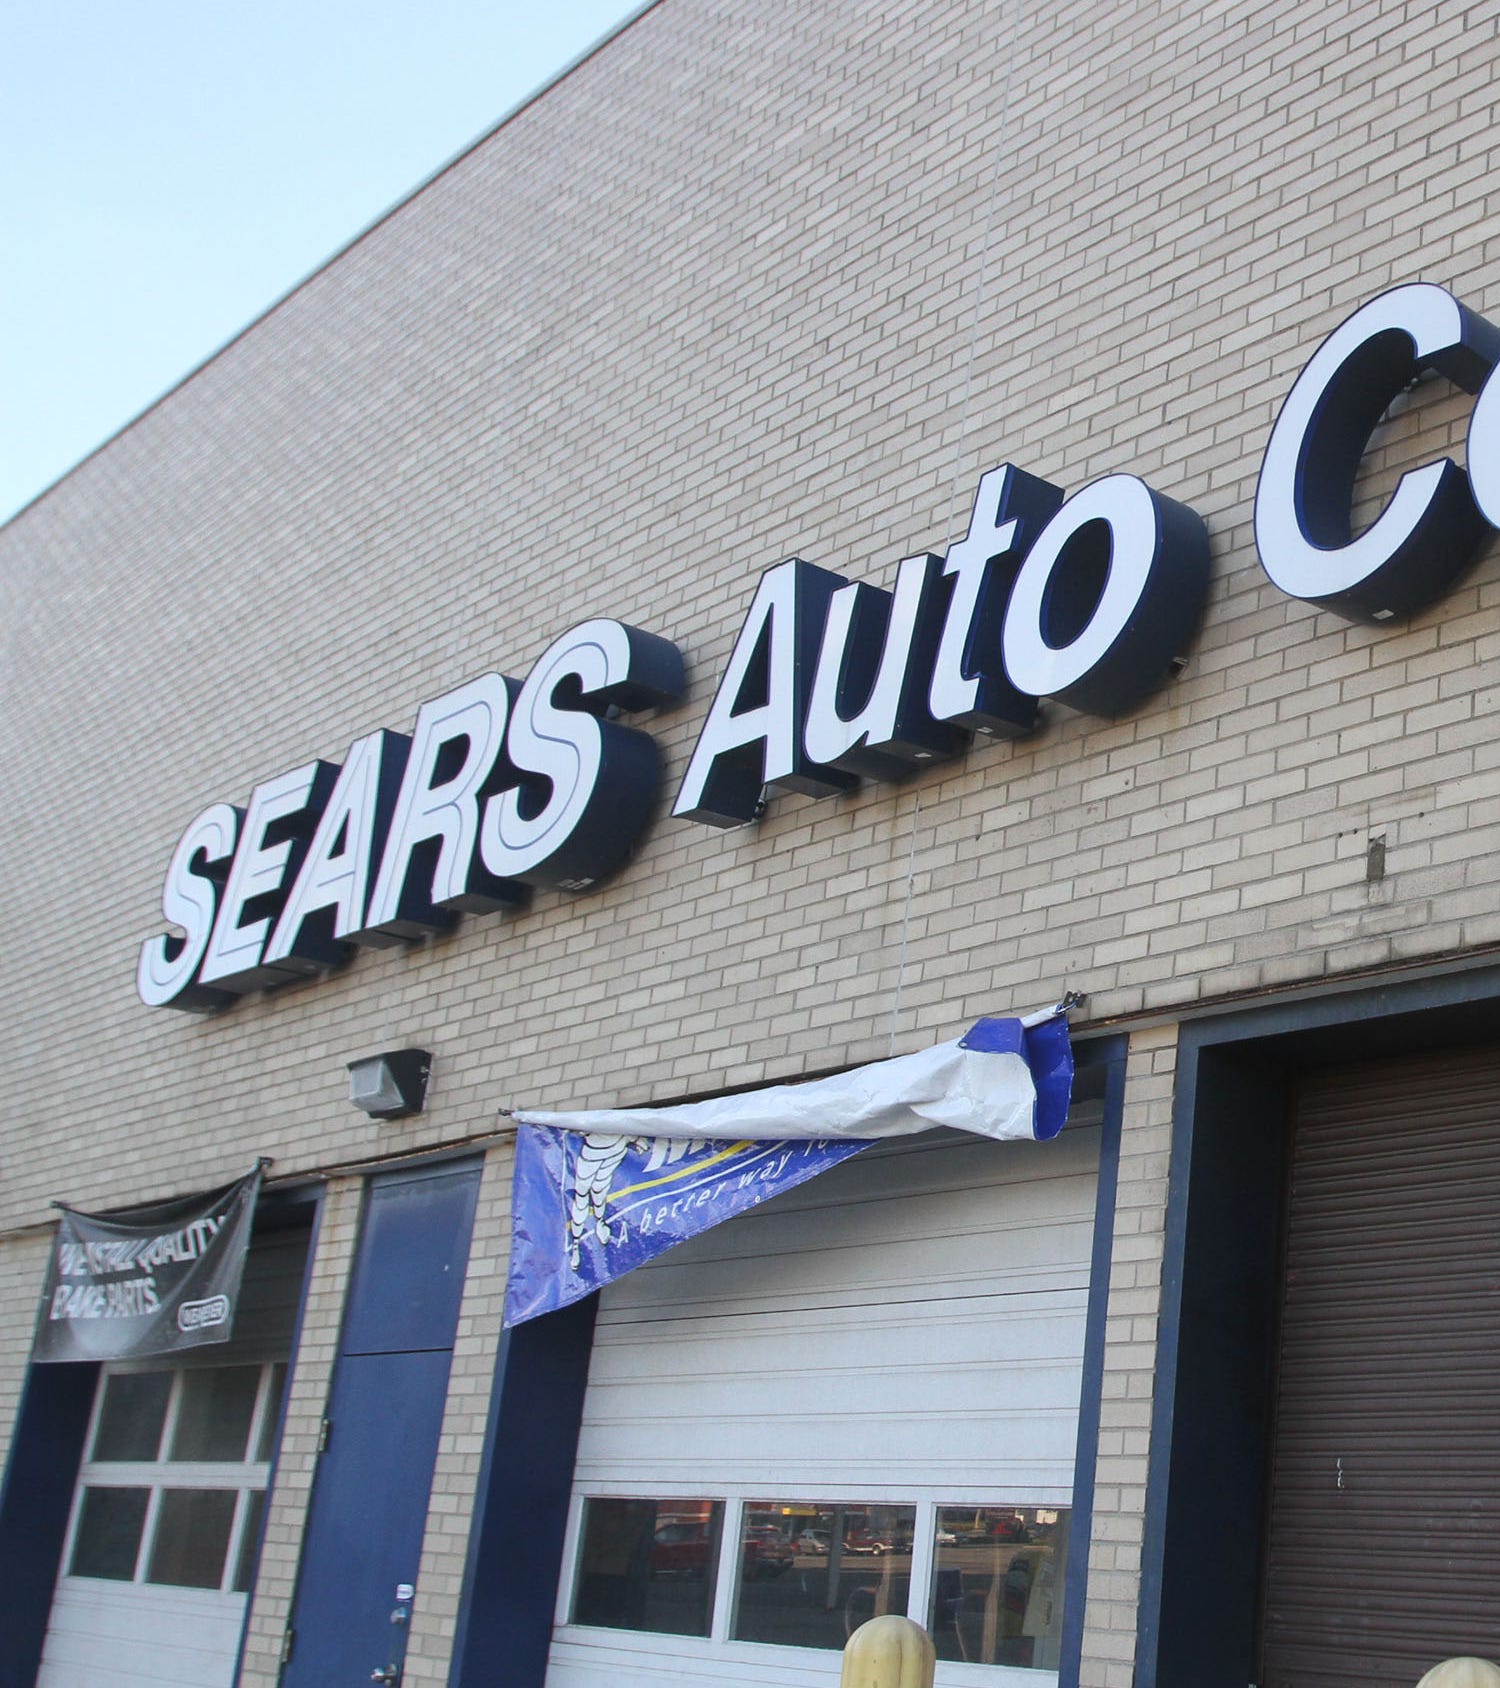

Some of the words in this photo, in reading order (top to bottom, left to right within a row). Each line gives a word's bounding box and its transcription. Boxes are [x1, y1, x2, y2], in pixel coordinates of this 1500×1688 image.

[136, 617, 633, 1008] SEARS
[671, 462, 1160, 818] Auto
[616, 1221, 629, 1248] A
[639, 1180, 726, 1235] better
[738, 1150, 793, 1189] way
[50, 1284, 106, 1320] BAKE
